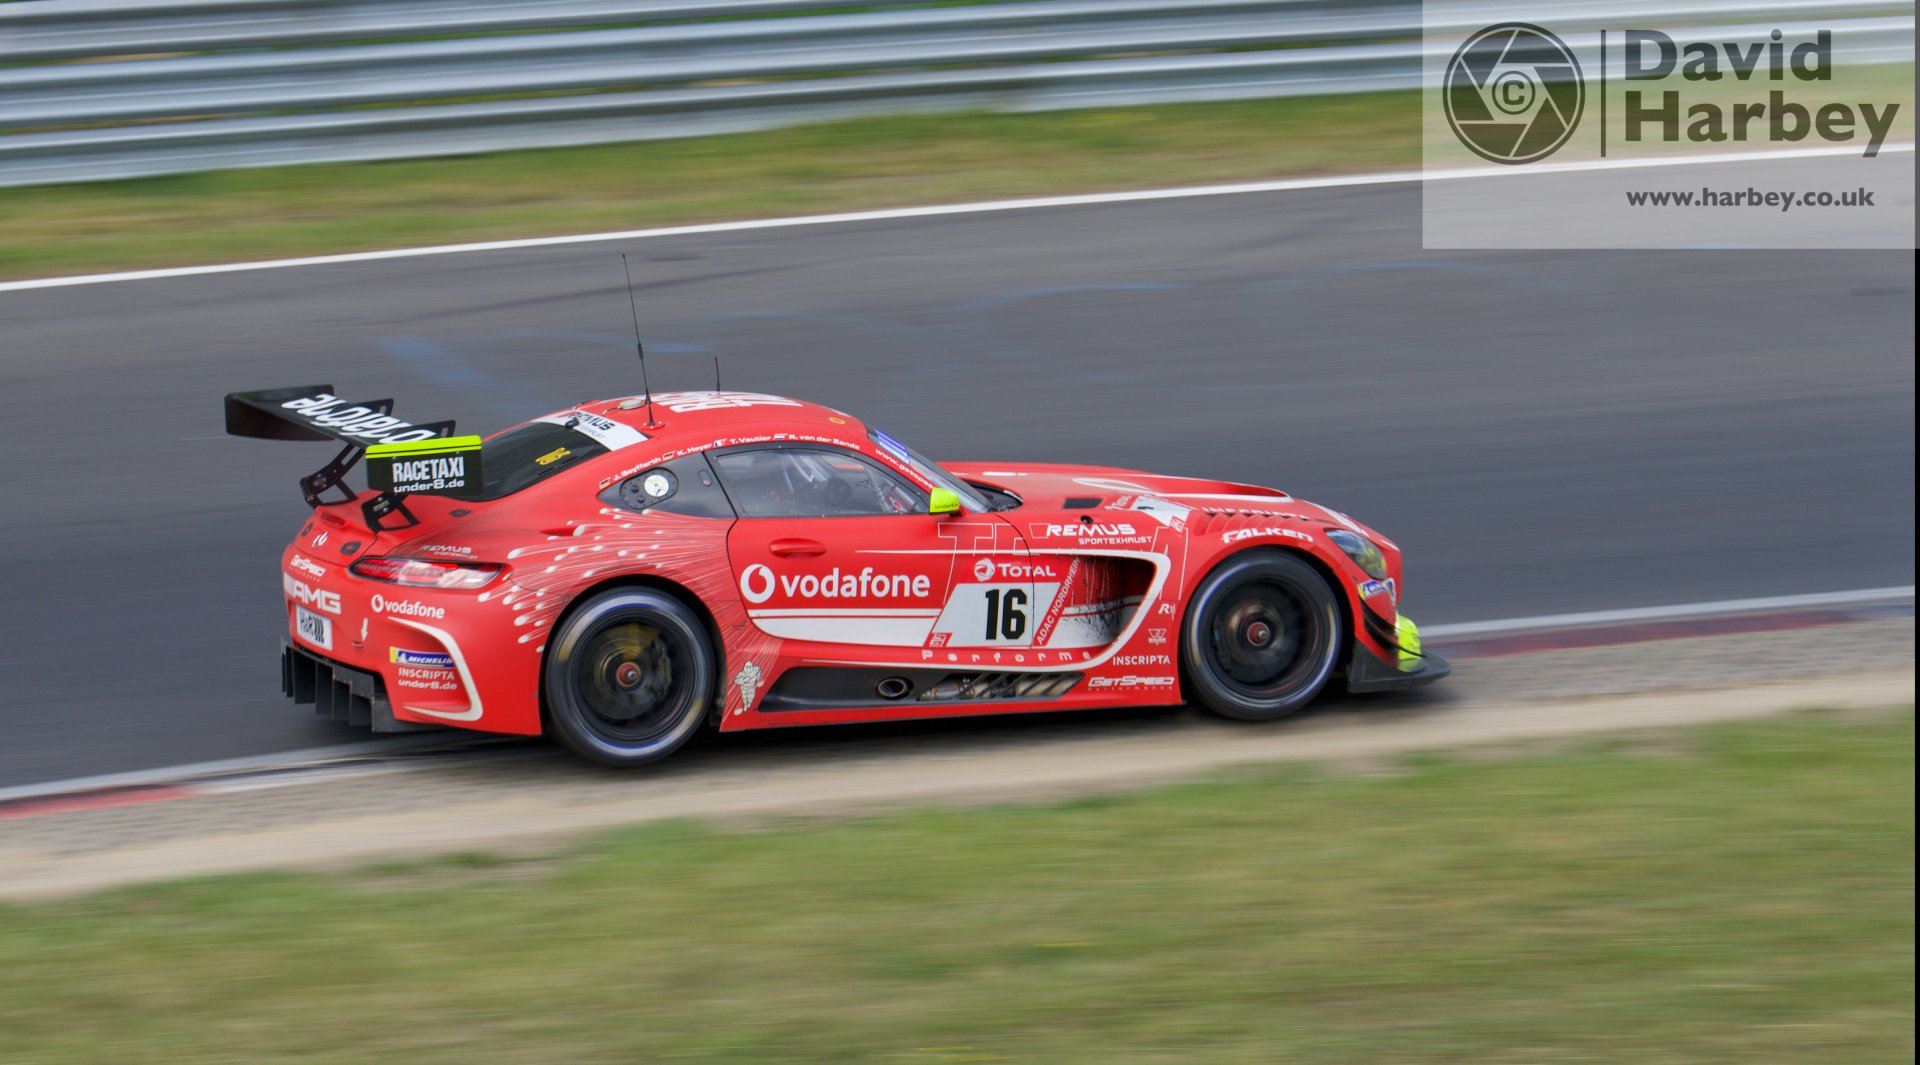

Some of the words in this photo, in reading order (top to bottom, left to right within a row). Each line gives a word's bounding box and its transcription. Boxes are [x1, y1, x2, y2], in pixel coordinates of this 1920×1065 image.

[281, 393, 437, 444] odafone
[392, 456, 465, 483] RACETAXI
[393, 478, 465, 494] under8.de
[1046, 523, 1137, 538] REMUS
[1222, 527, 1314, 544] FALKEN
[1078, 535, 1153, 546] SPORTEXHAUST
[998, 563, 1056, 577] TOTAL
[780, 567, 931, 598] vodafone
[293, 580, 341, 615] AMG
[1036, 616, 1055, 646] ADAC
[1051, 556, 1081, 617] NORDRHEIN
[383, 598, 445, 620] vodafone
[985, 588, 1027, 641] 16
[408, 655, 453, 665] MICHELIN
[1112, 655, 1171, 666] INSCRIPTA
[398, 666, 455, 681] INSCRIPTA
[398, 678, 458, 690] under8.de
